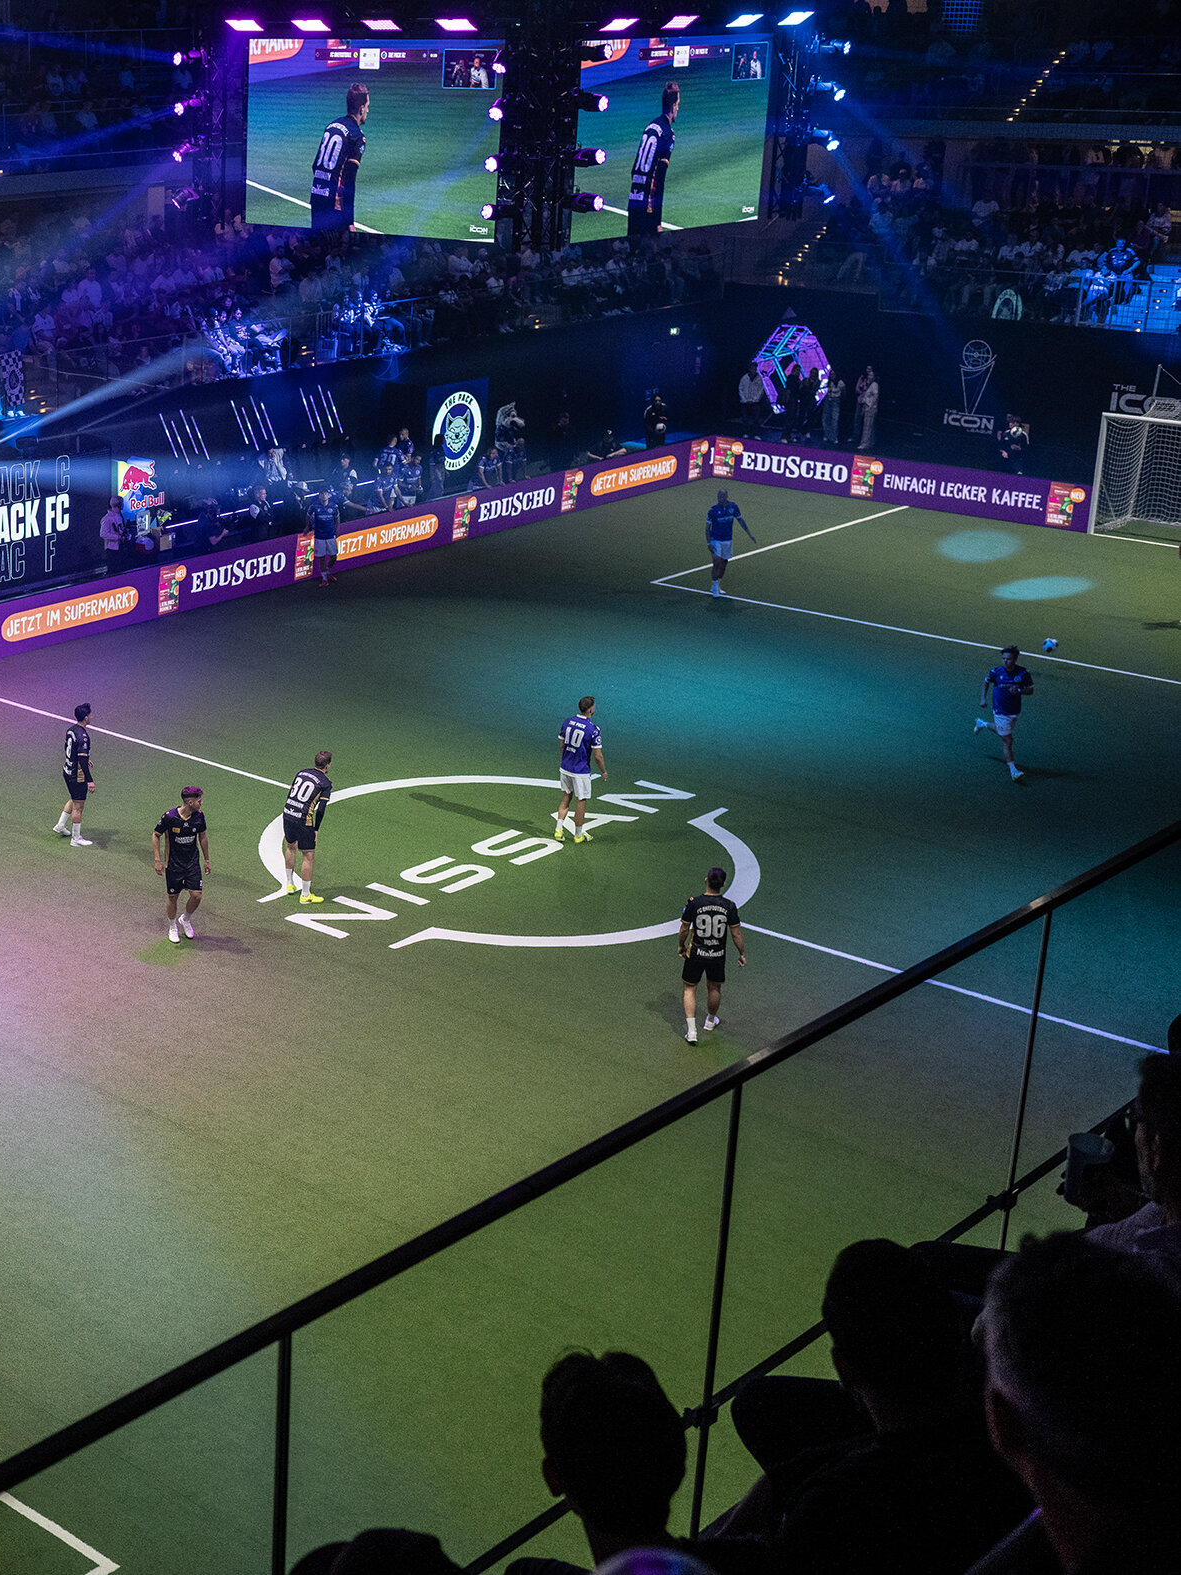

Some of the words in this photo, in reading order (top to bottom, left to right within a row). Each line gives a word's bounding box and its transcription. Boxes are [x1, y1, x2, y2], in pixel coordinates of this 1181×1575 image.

[1112, 383, 1137, 392] THE
[943, 413, 995, 431] ICON
[593, 473, 617, 492] JETZT
[618, 471, 628, 485] IM
[629, 459, 676, 482] SUPERMARKT
[740, 451, 848, 483] EDUSCHO
[130, 495, 147, 511] Red
[148, 491, 165, 507] Bull
[478, 486, 555, 522] EDUSCHO
[883, 473, 936, 495] EINFACH
[940, 481, 988, 503] LECKER
[991, 488, 1043, 511] KAFFEE.
[45, 493, 70, 534] FC
[337, 535, 363, 555] JETZT
[366, 532, 378, 548] IM
[380, 518, 437, 544] SUPERMARKT
[191, 552, 286, 593] EDUSCHO
[6, 613, 42, 637] JETZT
[46, 609, 61, 627] IM
[64, 590, 136, 621] SUPERMARKT
[564, 726, 585, 748] 10
[290, 777, 315, 802] 30
[284, 780, 696, 939] NISSAN
[696, 914, 727, 938] 96
